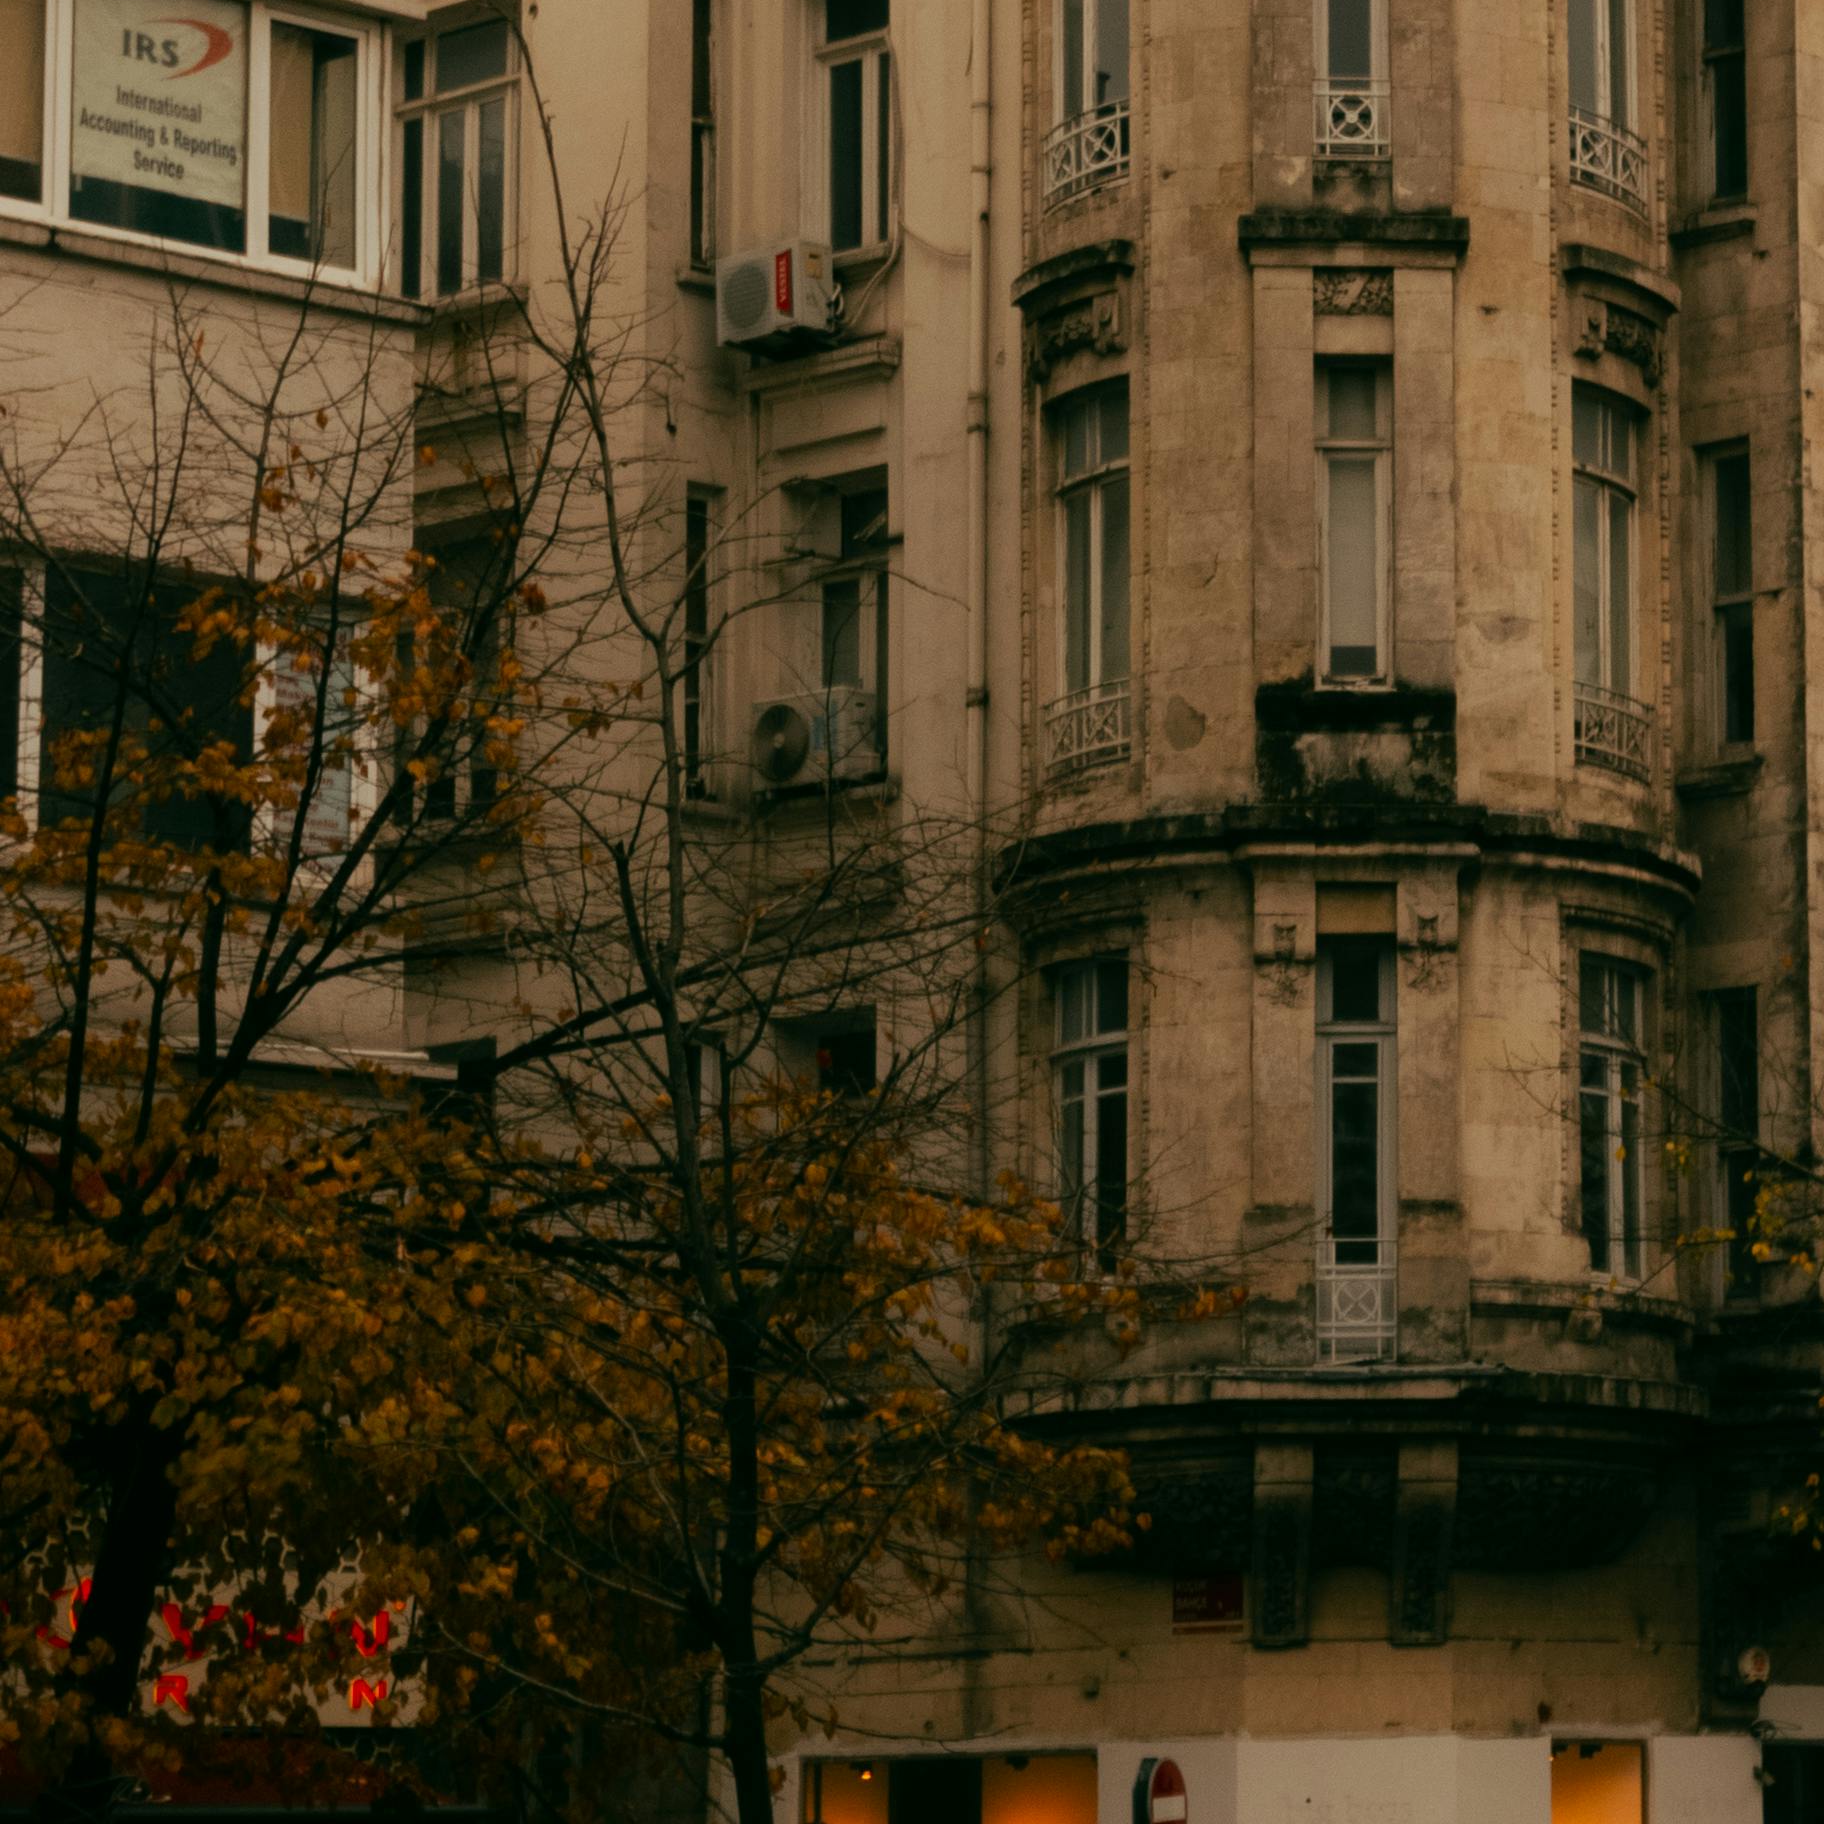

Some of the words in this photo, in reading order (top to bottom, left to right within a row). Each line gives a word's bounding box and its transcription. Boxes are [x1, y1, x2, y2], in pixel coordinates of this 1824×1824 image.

[122, 28, 179, 68] IRS
[116, 85, 202, 123] International
[80, 106, 155, 148] Accounting
[160, 126, 168, 145] &
[174, 128, 237, 166] Reporting
[134, 149, 184, 179] Service
